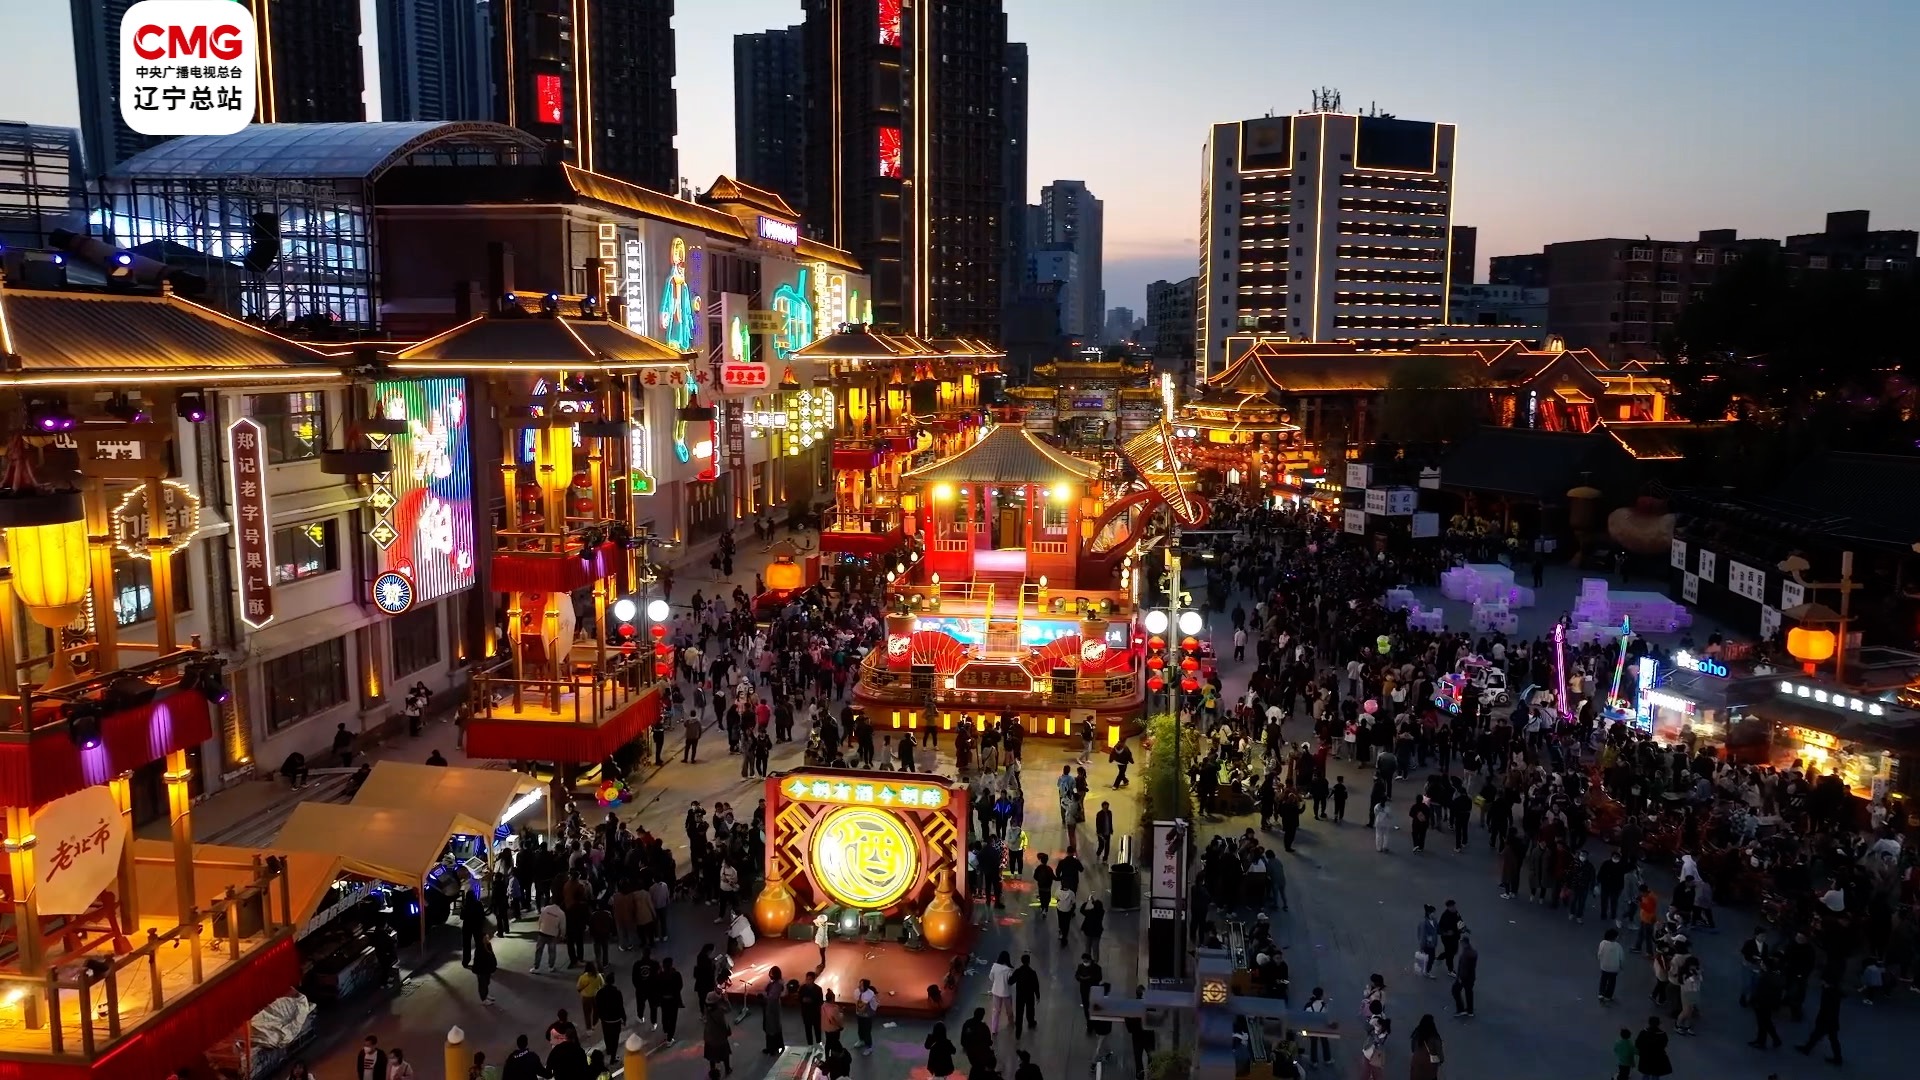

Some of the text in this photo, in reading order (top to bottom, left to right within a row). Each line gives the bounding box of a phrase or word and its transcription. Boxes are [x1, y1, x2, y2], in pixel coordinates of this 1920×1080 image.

[643, 371, 709, 386] 老汽水
[237, 432, 266, 615] 郑记老字号果仁酥
[788, 780, 943, 807] 今朝有酒今朝醉
[46, 818, 110, 883] 老北市
